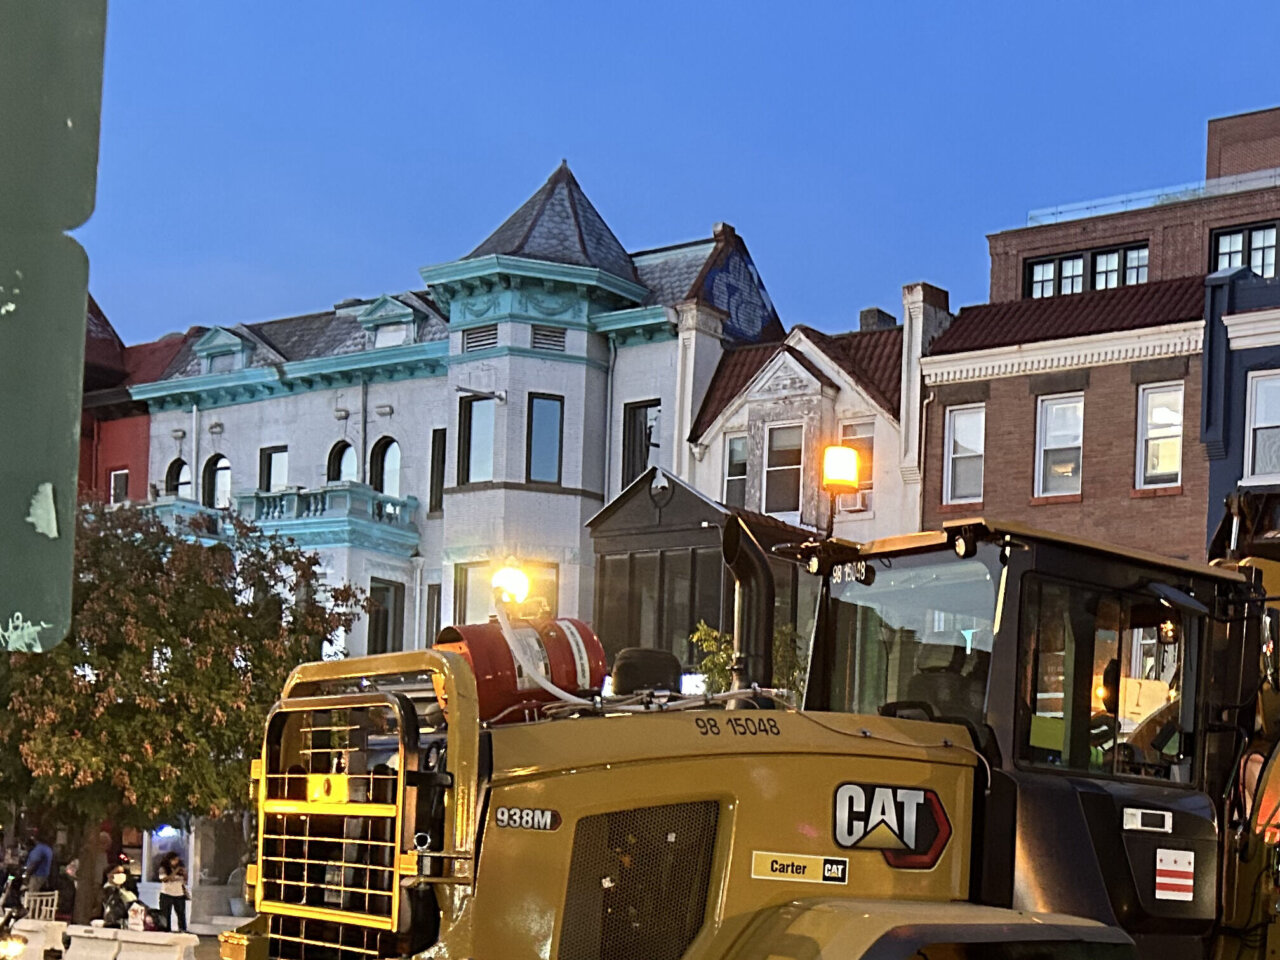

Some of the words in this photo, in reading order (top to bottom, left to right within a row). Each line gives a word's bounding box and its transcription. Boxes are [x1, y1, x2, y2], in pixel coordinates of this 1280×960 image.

[832, 564, 842, 584] 98
[695, 717, 721, 736] 98
[726, 717, 781, 736] 15048
[496, 806, 552, 830] 938M
[835, 784, 925, 851] CAT
[770, 859, 807, 876] Carter
[824, 863, 845, 878] CAT
